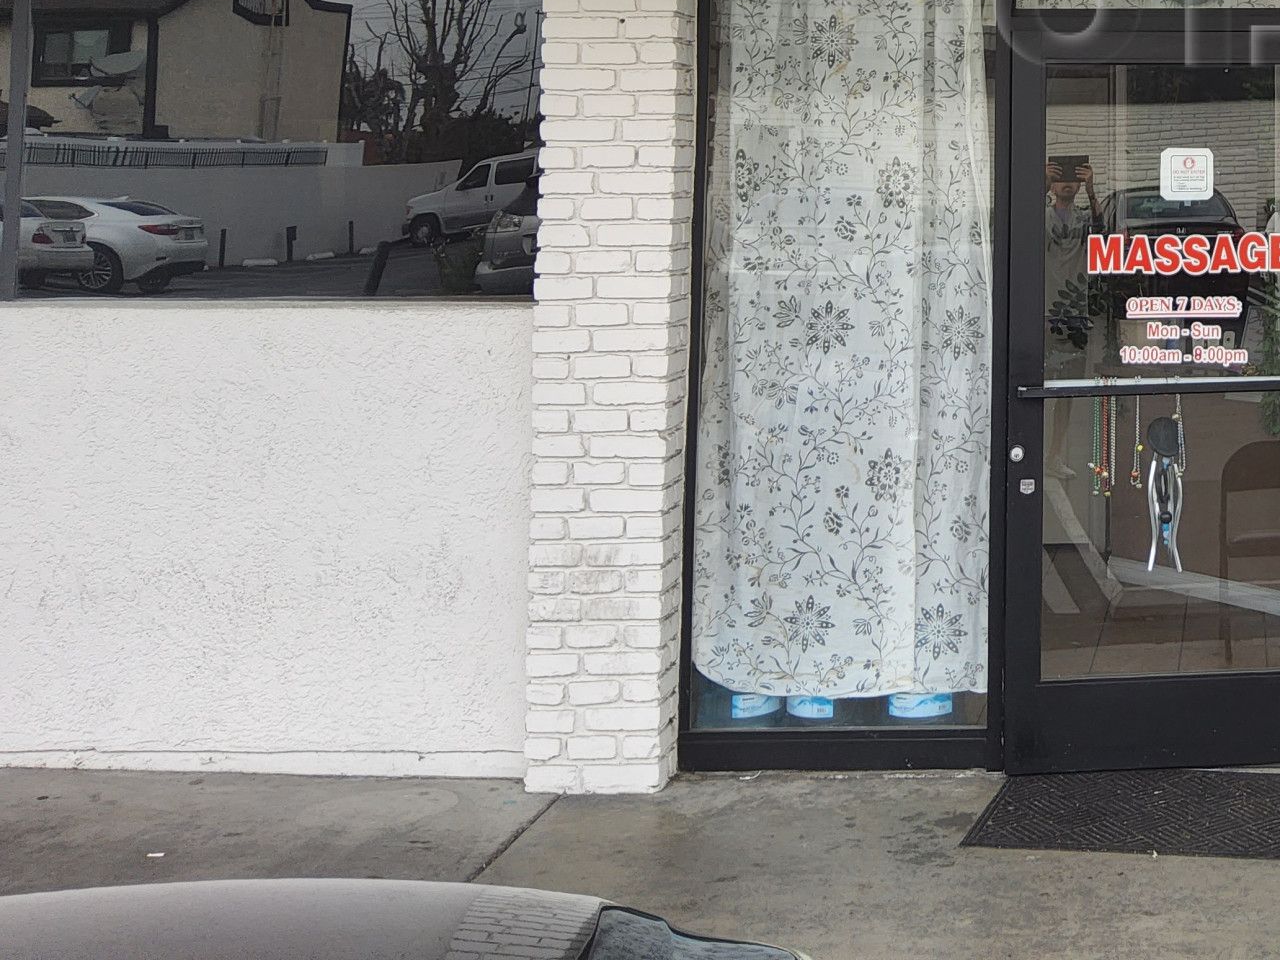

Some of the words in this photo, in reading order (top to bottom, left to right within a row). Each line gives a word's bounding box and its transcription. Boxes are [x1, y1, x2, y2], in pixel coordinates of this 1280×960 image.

[1127, 298, 1172, 313] OPEN
[1176, 298, 1188, 313] 7
[1147, 322, 1179, 339] Mon
[1191, 322, 1221, 339] Sun
[1120, 346, 1181, 363] 10:00am
